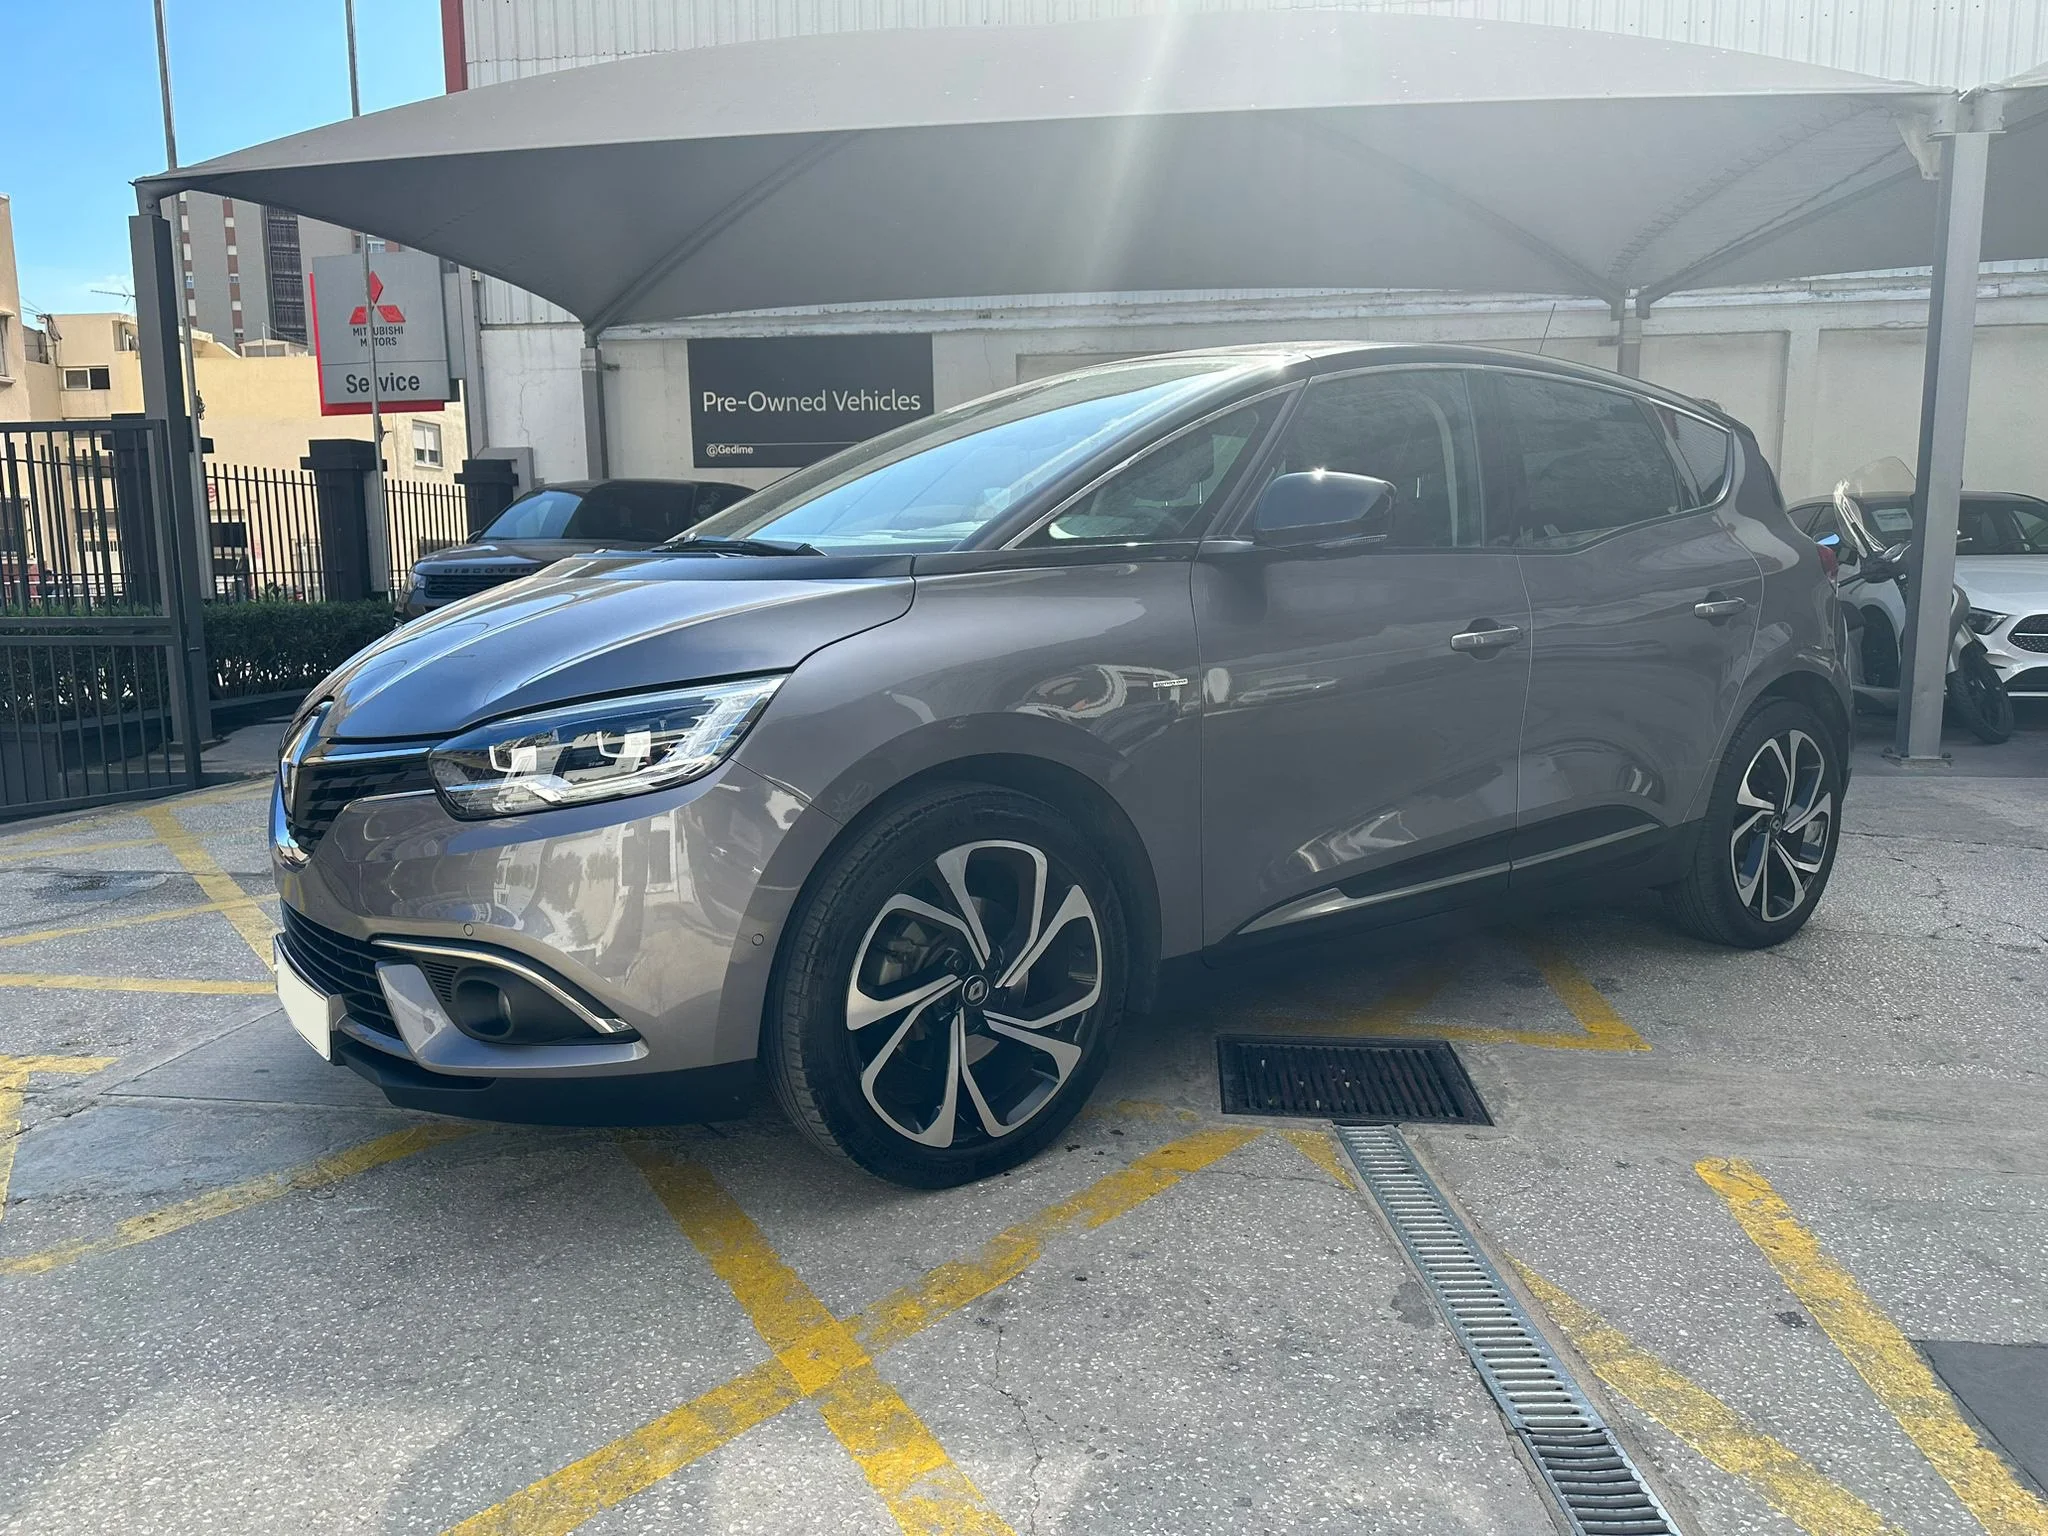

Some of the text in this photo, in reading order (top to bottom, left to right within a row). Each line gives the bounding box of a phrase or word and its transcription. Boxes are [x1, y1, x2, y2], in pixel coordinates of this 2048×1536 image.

[353, 326, 404, 336] MITUBISHI
[360, 337, 397, 347] MTORS
[346, 372, 420, 394] Sevice
[703, 388, 921, 412] Pre-Owned Vehicles
[443, 567, 538, 575] DISCOVER
